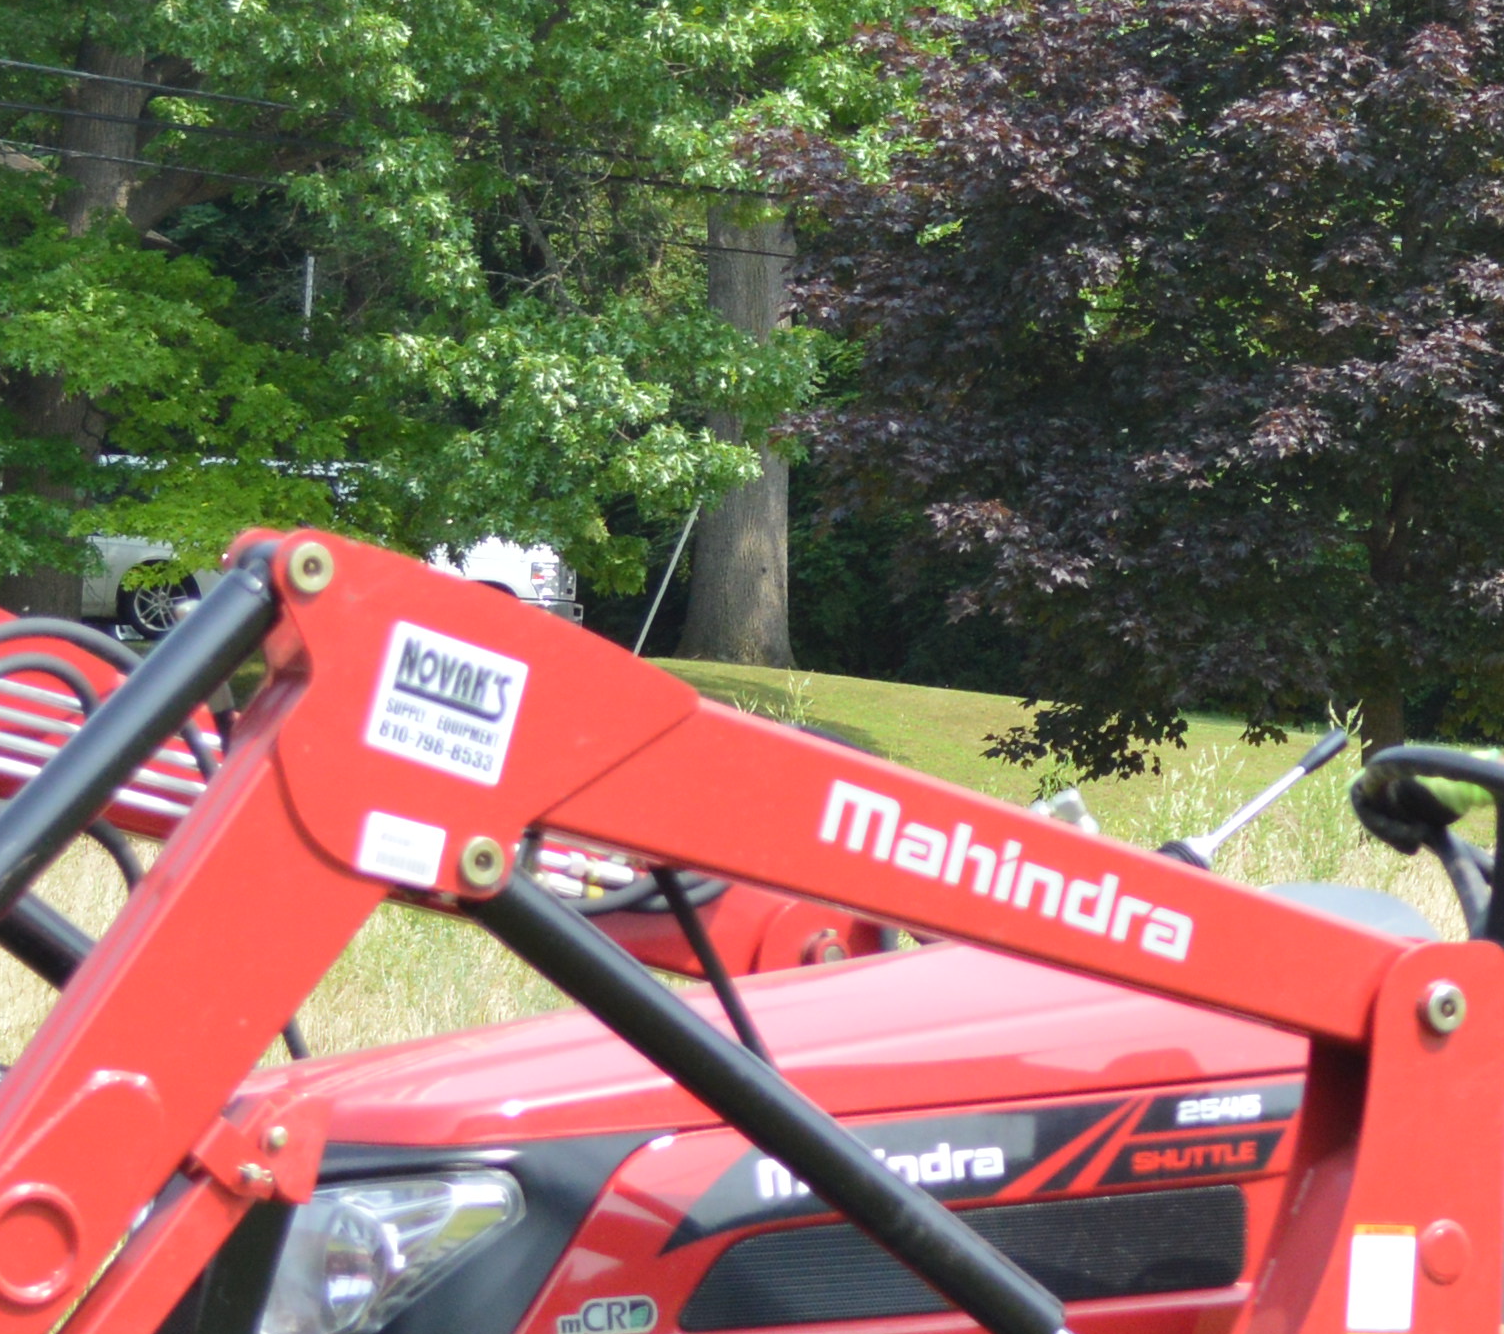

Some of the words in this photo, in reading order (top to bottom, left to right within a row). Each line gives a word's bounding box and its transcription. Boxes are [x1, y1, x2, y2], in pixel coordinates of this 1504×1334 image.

[385, 697, 426, 723] SUPPLY
[437, 714, 500, 748] EQUIPMENT
[819, 779, 1194, 961] Mahindra
[1131, 1141, 1257, 1174] SHUTTLE
